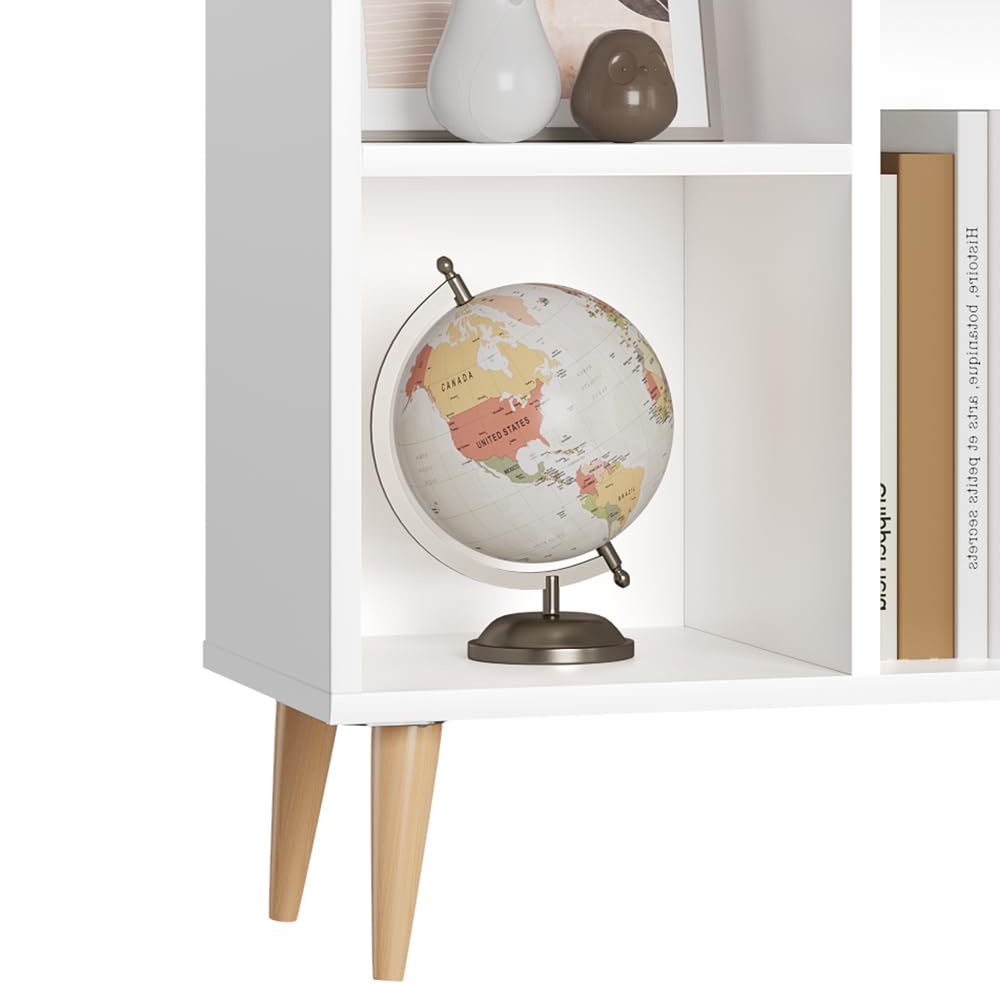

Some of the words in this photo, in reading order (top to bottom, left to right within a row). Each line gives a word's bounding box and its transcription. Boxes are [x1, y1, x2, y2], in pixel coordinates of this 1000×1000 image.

[441, 371, 474, 392] CANADA
[476, 431, 503, 449] UNITED
[503, 416, 530, 436] STATES
